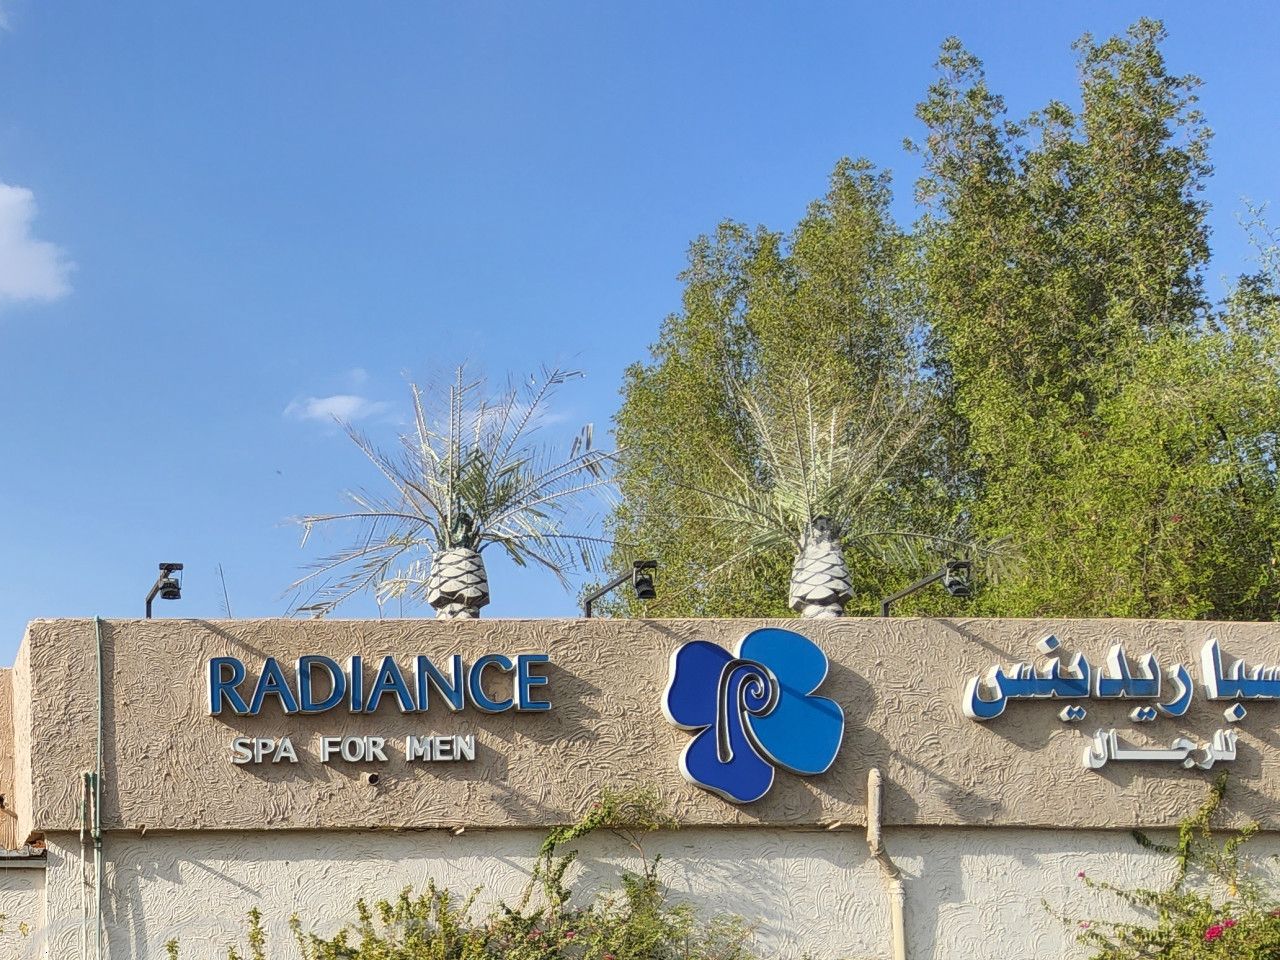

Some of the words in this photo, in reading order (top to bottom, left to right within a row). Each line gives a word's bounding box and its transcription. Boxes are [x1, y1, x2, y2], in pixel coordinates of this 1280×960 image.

[207, 653, 552, 716] RADIANCE
[961, 634, 1195, 721] ريدينس
[230, 736, 298, 764] SPA
[320, 735, 388, 762] FOR
[405, 734, 475, 762] MEN
